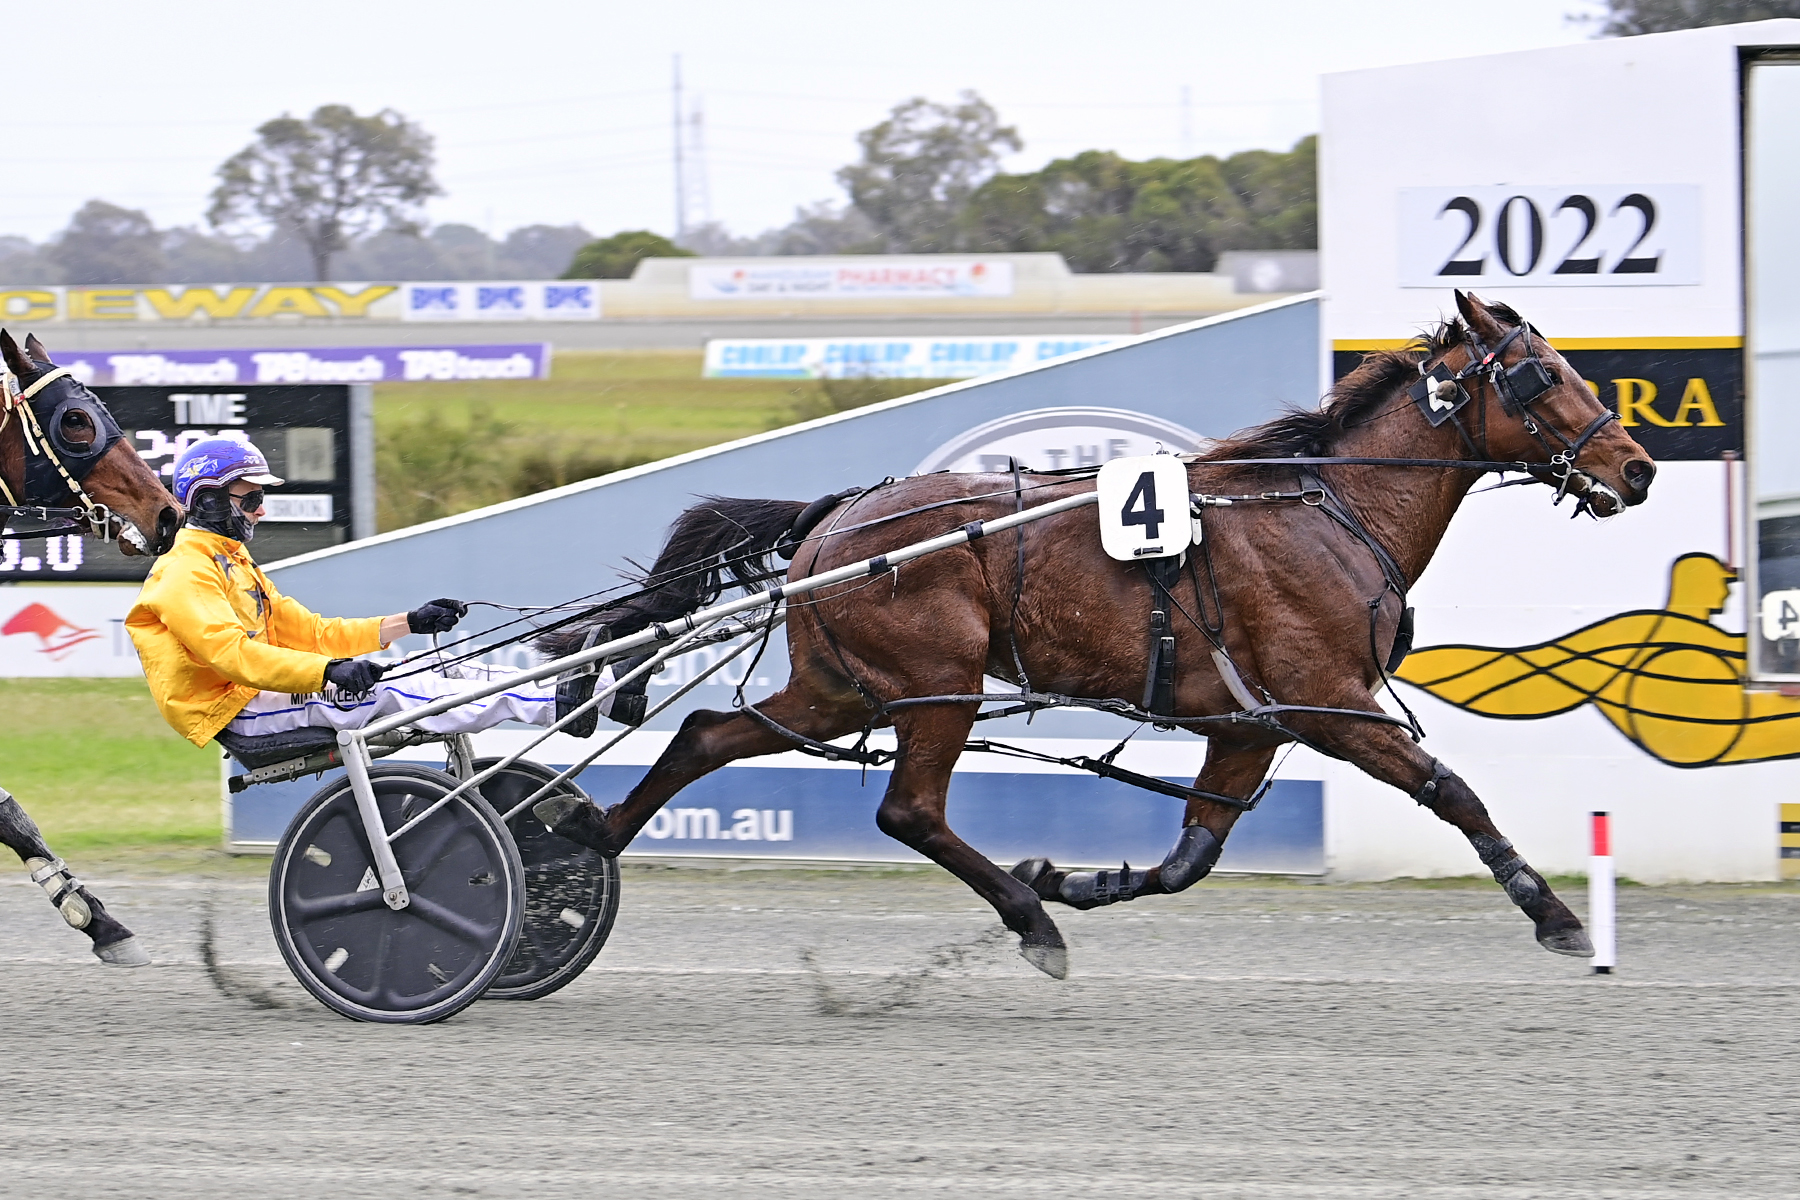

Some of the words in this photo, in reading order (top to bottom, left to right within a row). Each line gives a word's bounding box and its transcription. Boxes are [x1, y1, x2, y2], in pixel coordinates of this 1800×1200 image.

[1436, 192, 1665, 277] 2022
[169, 393, 248, 424] TIME
[1584, 378, 1726, 427] RA
[1044, 438, 1130, 471] THE
[1121, 471, 1164, 539] 4
[633, 807, 794, 842] om.au
